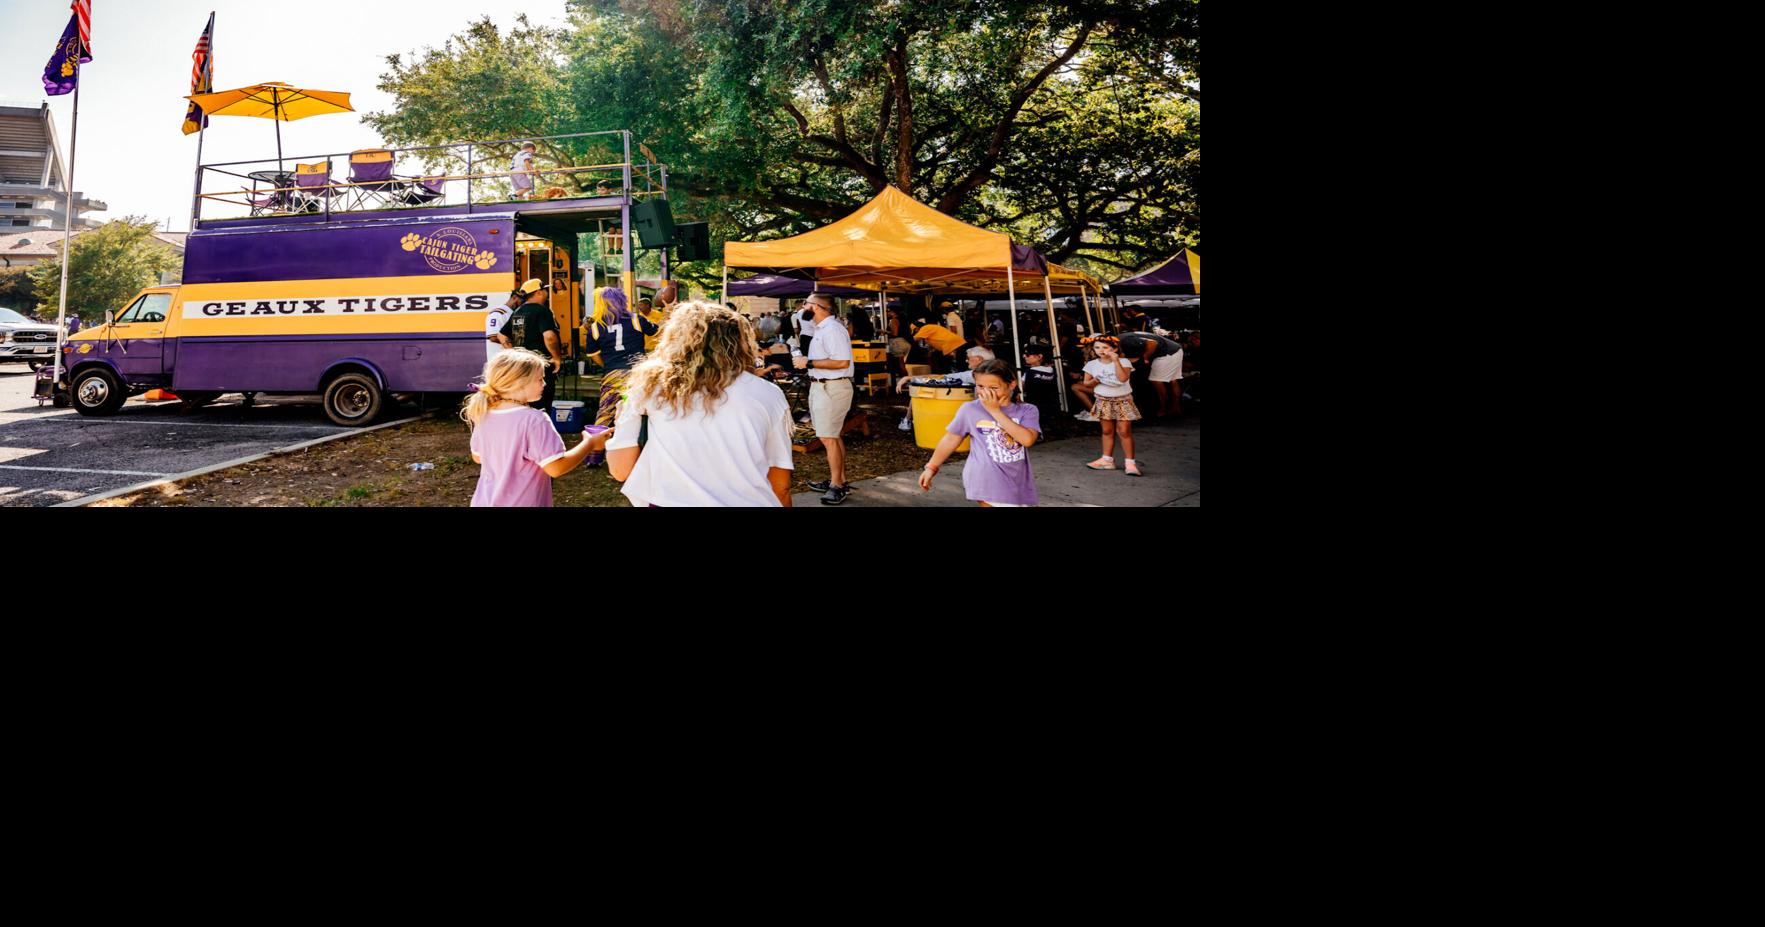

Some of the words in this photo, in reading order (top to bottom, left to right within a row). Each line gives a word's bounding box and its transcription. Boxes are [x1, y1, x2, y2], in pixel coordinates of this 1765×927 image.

[420, 245, 474, 265] TAILGATING
[422, 237, 448, 249] CAJUN
[451, 243, 478, 256] TIGER
[202, 300, 325, 316] GEAUX
[338, 295, 489, 312] TIGERS
[490, 318, 497, 327] 9
[607, 323, 625, 351] 7
